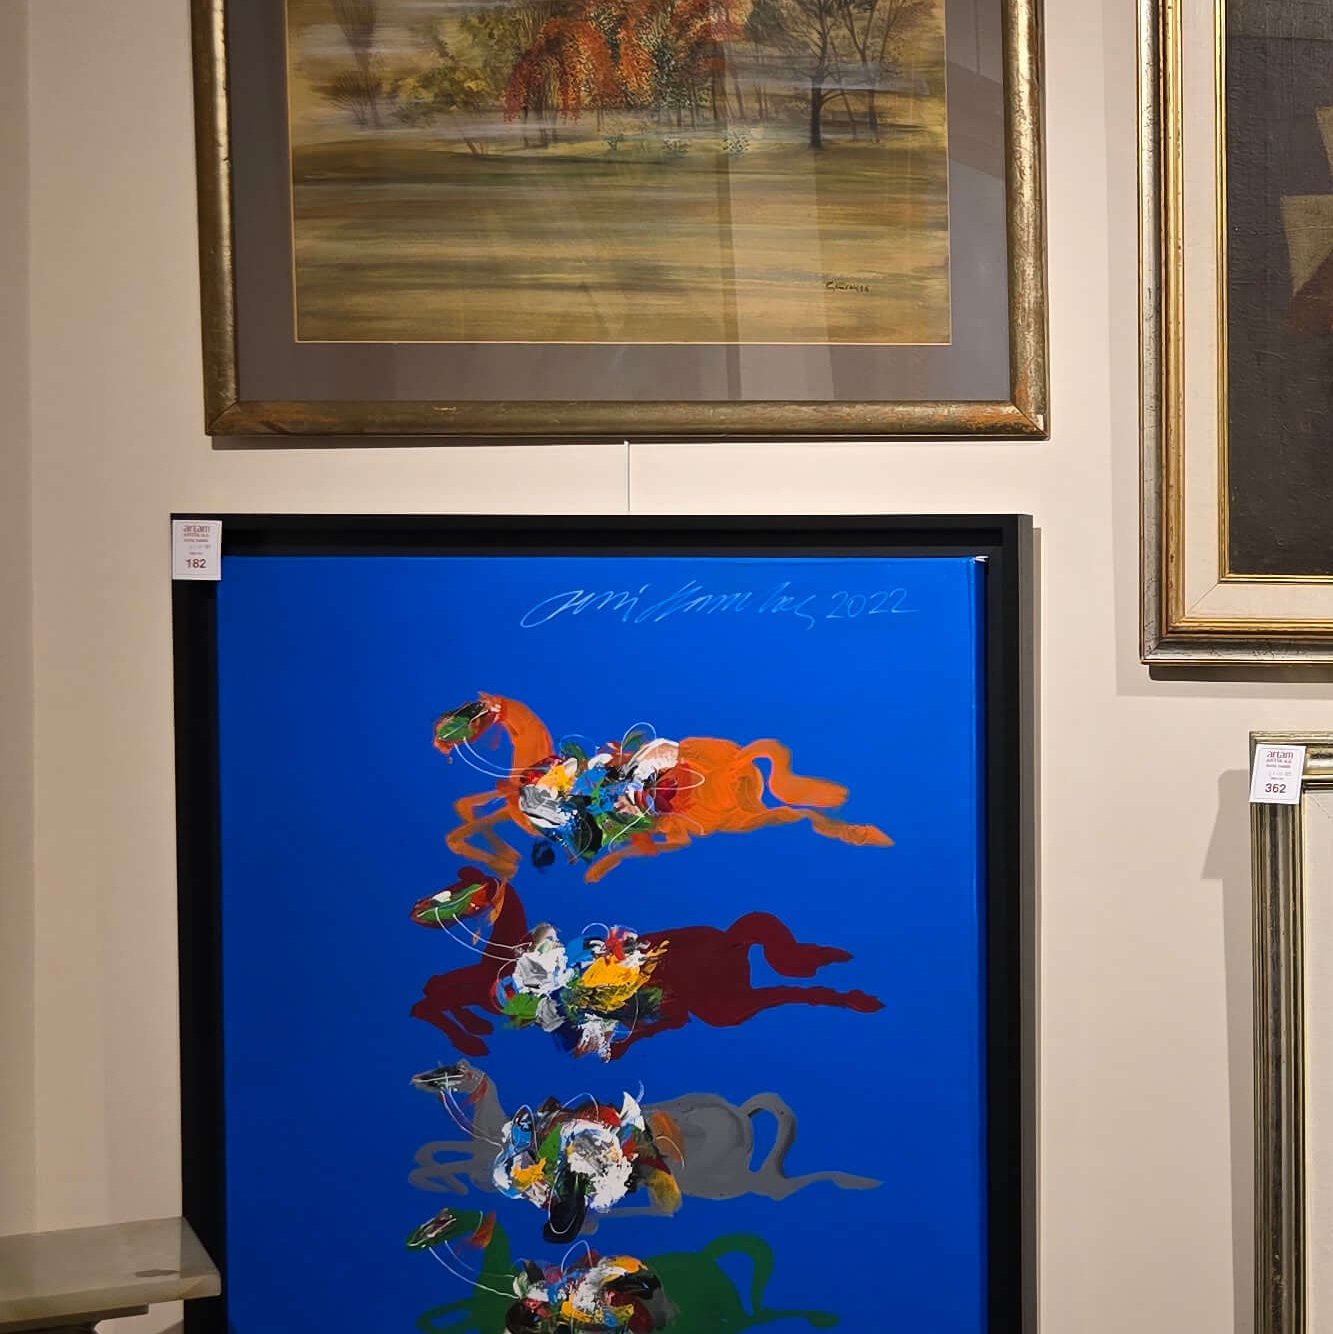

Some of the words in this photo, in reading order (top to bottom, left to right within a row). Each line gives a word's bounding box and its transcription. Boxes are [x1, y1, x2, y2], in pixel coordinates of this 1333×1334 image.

[185, 558, 207, 569] 182
[826, 587, 920, 620] 2022
[1265, 782, 1287, 794] 362
